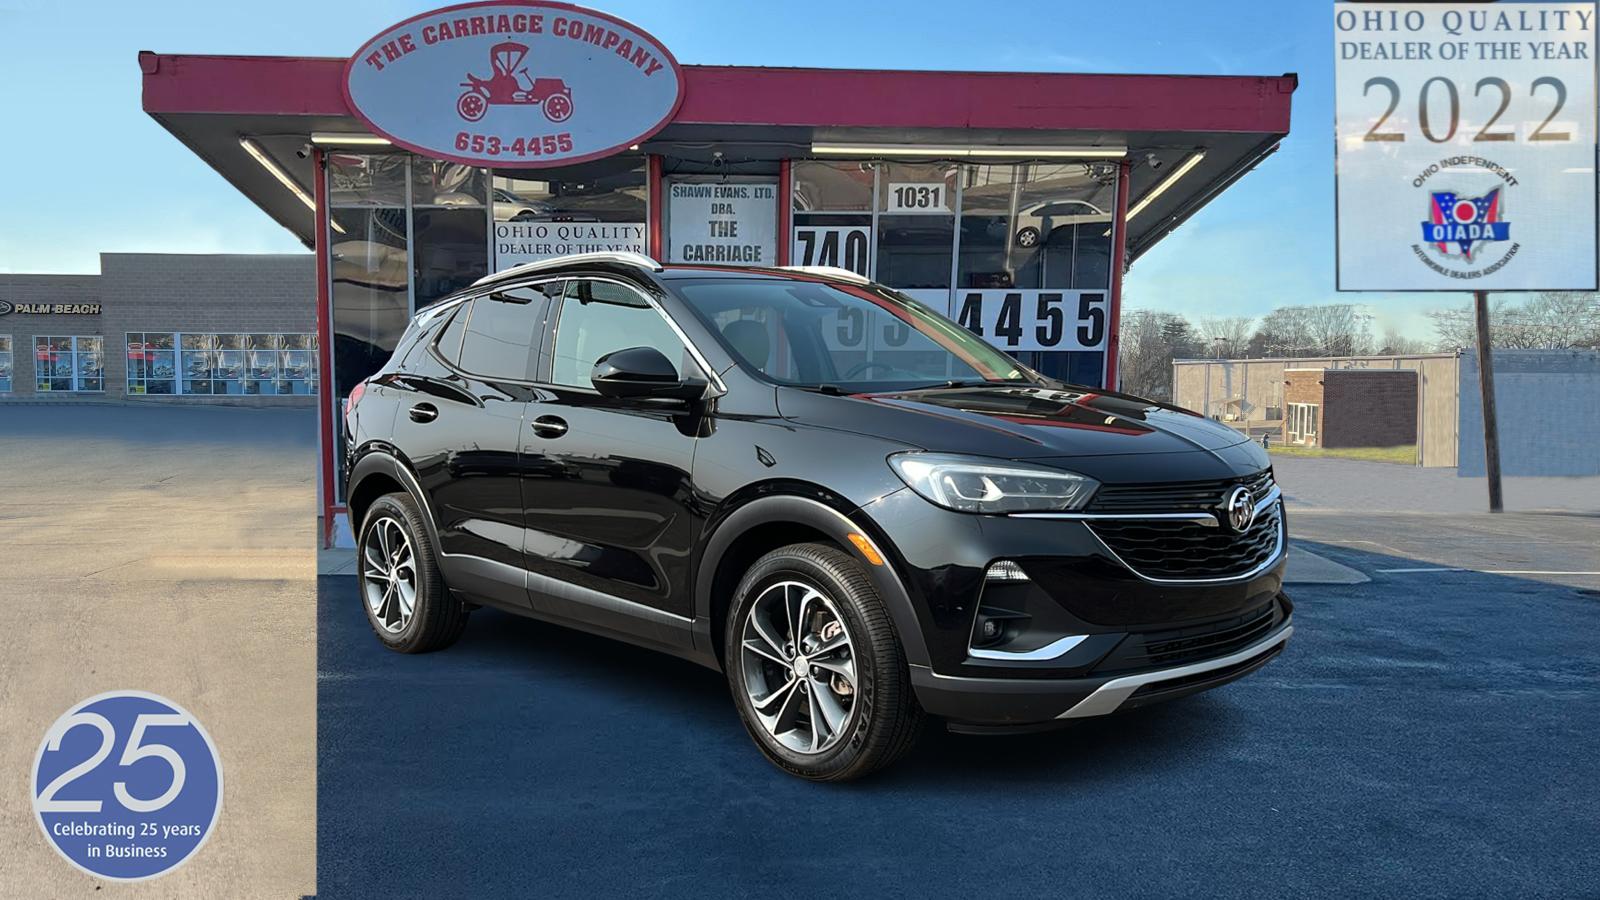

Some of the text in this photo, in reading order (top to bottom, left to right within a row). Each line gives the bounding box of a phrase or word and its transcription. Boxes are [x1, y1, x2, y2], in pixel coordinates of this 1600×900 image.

[1336, 10, 1592, 36] OHIO QUALITY
[366, 14, 664, 78] THE CARRIAGE COMPANY
[1340, 42, 1589, 60] DEALER OF THE YEAR
[1363, 76, 1571, 144] 2022
[455, 132, 573, 156] 653-4455
[1412, 156, 1519, 188] OHIO INDEPENDENT
[673, 186, 711, 198] SHAWN
[754, 187, 775, 199] LTD.
[894, 186, 940, 208] 1031
[711, 203, 736, 215] DBA.
[497, 226, 643, 241] OHIO QUALITY
[708, 221, 738, 238] THE
[1432, 223, 1495, 241] OIADA
[499, 244, 641, 255] DEALER OF THE YEAR
[683, 244, 762, 262] CARRIAGE
[797, 230, 868, 279] 740
[1411, 242, 1520, 280] AUTOMOBILE DEALERS ASSOCIATION
[15, 303, 100, 314] PALM BEACH
[957, 292, 1105, 348] 4455
